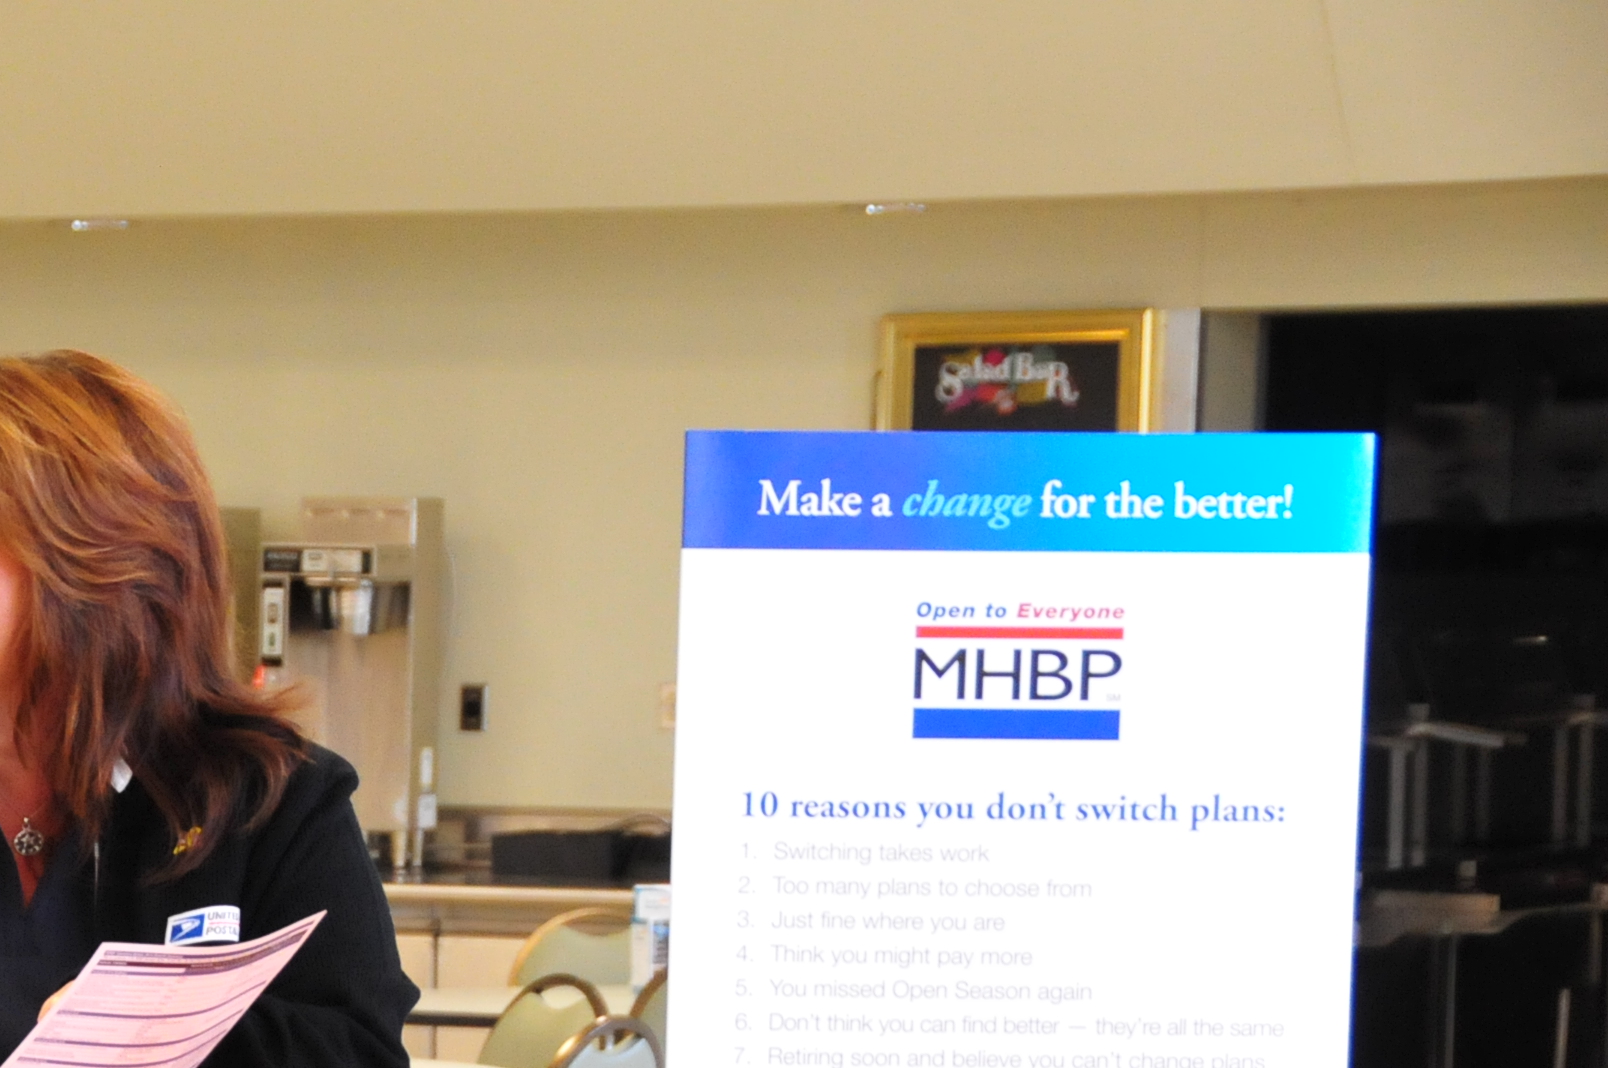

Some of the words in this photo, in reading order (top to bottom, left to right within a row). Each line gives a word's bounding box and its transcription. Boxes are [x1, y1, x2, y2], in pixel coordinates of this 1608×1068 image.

[757, 478, 862, 518] Make
[871, 492, 892, 518] a
[902, 479, 1033, 529] change
[1039, 481, 1095, 519] for
[1104, 482, 1163, 519] the
[1173, 482, 1294, 520] better!
[916, 602, 977, 622] Open
[984, 602, 1007, 619] to
[1017, 603, 1125, 622] Everyone
[913, 647, 1123, 701] MHBP
[745, 792, 778, 816] 10
[792, 801, 906, 818] reasons
[917, 803, 973, 828] you
[986, 792, 1063, 820] don't
[1077, 794, 1177, 821] switch
[1191, 794, 1284, 831] plans:
[742, 842, 756, 859] 1.
[774, 841, 872, 866] Switching
[879, 844, 933, 862] takes
[940, 845, 990, 862] work
[738, 876, 755, 894] 2.
[773, 875, 809, 895] Too
[816, 881, 871, 899] many
[877, 878, 931, 899] plans
[938, 879, 958, 897] to
[964, 879, 1040, 897] choose
[1046, 879, 1092, 898] from
[737, 910, 754, 928] 3.
[771, 911, 813, 929] Just
[821, 911, 856, 930] fine
[862, 912, 924, 930] where
[930, 916, 967, 934] you
[973, 917, 1005, 931] are
[736, 945, 753, 962] 4.
[771, 944, 824, 963] Think
[831, 949, 867, 967] you
[874, 947, 930, 969] might
[937, 951, 974, 969] pay
[981, 951, 1033, 966] more
[735, 978, 752, 997] 5.
[770, 979, 807, 997] You
[814, 980, 886, 998] missed
[892, 980, 948, 1002] Open
[955, 980, 1031, 1000] Season
[1037, 983, 1092, 1005] again
[735, 1012, 752, 1031] 6.
[827, 1014, 873, 1032] think
[879, 1018, 914, 1036] you
[920, 1019, 956, 1033] can
[962, 1015, 997, 1034] find
[1003, 1016, 1060, 1035] better
[1167, 1018, 1187, 1036] all
[1193, 1019, 1224, 1036] the
[1230, 1023, 1284, 1037] same
[734, 1046, 750, 1064] 7.
[851, 1052, 900, 1067] soon
[907, 1050, 945, 1067] and
[952, 1050, 1022, 1068] believe
